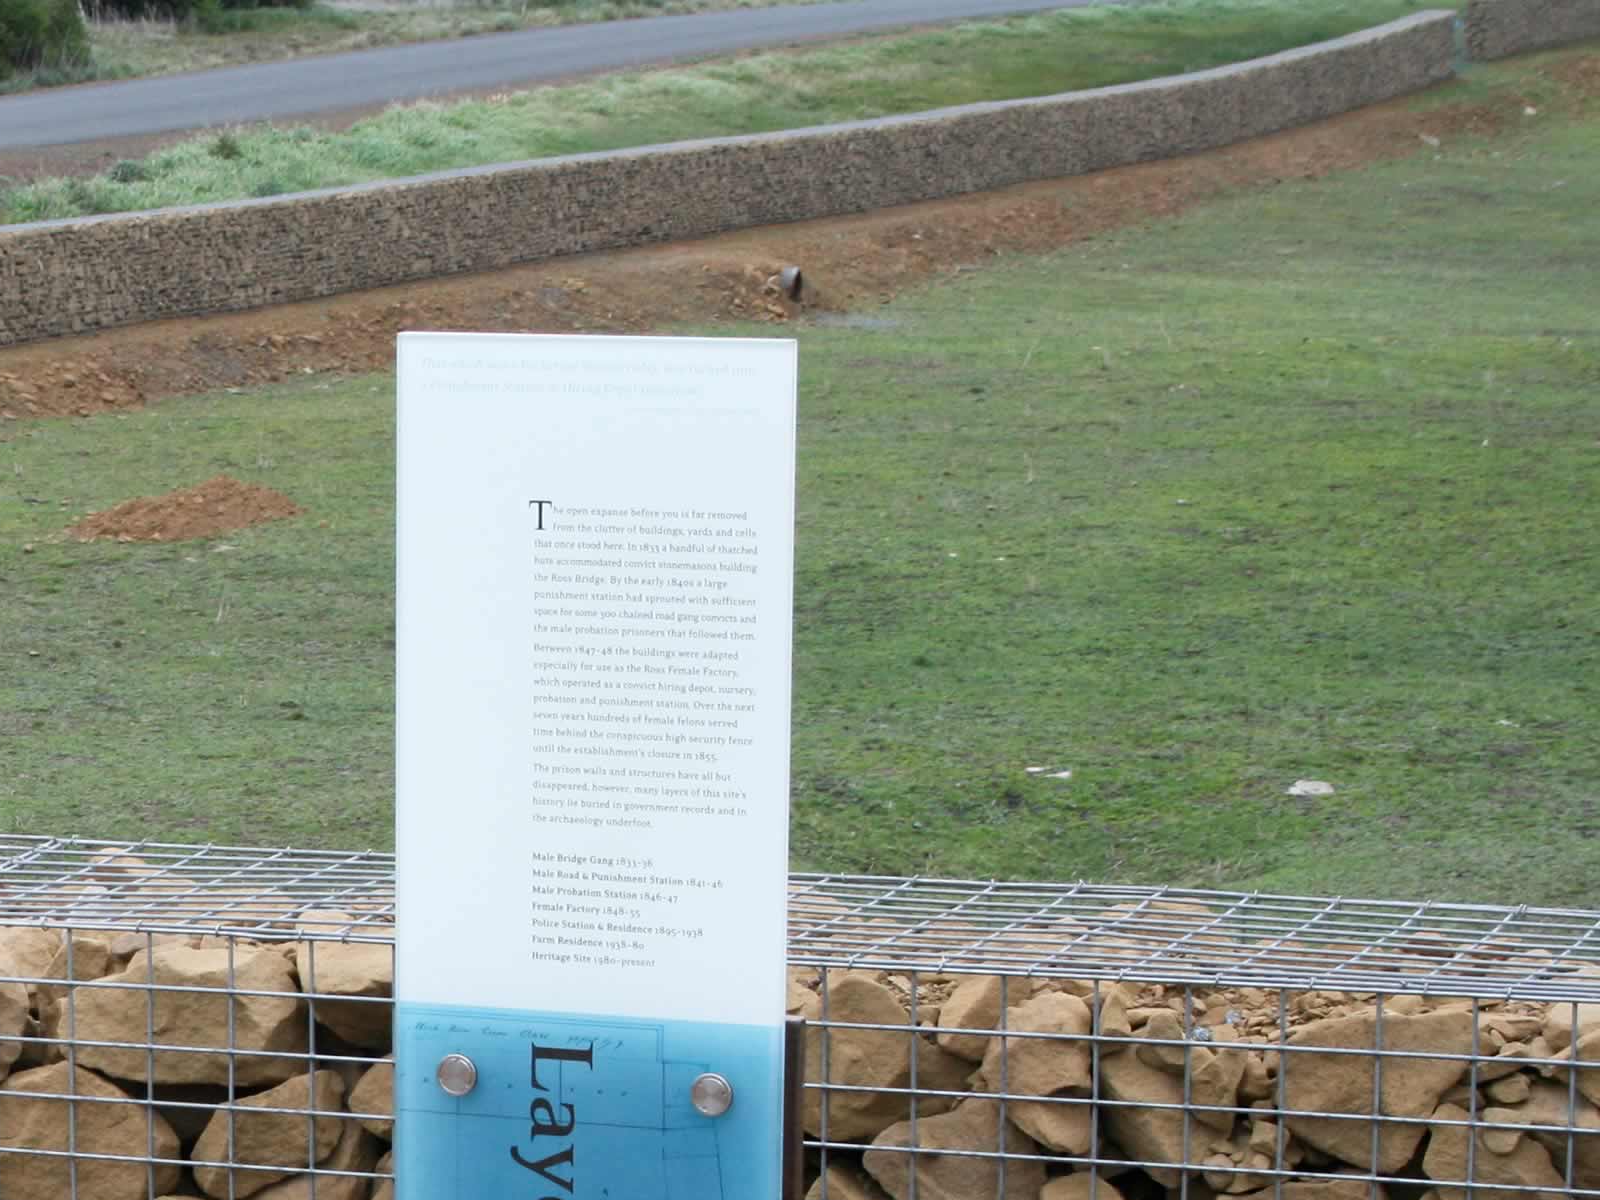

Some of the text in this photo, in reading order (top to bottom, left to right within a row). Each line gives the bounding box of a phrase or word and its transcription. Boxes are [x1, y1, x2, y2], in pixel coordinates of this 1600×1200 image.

[566, 508, 588, 518] open
[591, 508, 628, 519] expanse
[631, 507, 659, 518] before
[662, 511, 679, 521] you
[691, 509, 705, 519] far
[707, 510, 747, 520] removed
[553, 522, 575, 532] from
[578, 523, 592, 532] the
[594, 523, 624, 533] clutter
[627, 524, 636, 534] of
[687, 526, 713, 539] yards
[716, 527, 733, 537] and
[534, 538, 552, 548] that
[627, 541, 637, 551] In
[669, 543, 704, 553] handful
[706, 544, 716, 554] of
[718, 544, 758, 555] thatched
[624, 558, 656, 569] convict
[719, 562, 757, 575] building
[534, 572, 548, 582] the
[551, 573, 572, 583] Ross
[610, 575, 622, 587] By
[624, 575, 639, 585] the
[641, 576, 664, 589] early
[704, 578, 727, 591] large
[534, 589, 756, 607] punishment station had sprouted with sufficient
[560, 607, 572, 617] for
[701, 612, 737, 623] convicts
[740, 614, 756, 624] and
[534, 623, 548, 633] the
[550, 624, 572, 634] male
[575, 625, 619, 638] probation
[667, 628, 686, 638] that
[689, 629, 728, 640] followed
[534, 643, 572, 653] Between
[615, 646, 630, 656] the
[632, 647, 675, 660] buildings
[678, 650, 699, 658] were
[702, 649, 738, 662] adapted
[580, 662, 593, 671] for
[596, 664, 612, 672] use
[626, 663, 641, 673] the
[644, 664, 666, 674] Ross
[668, 665, 700, 675] Female
[534, 676, 560, 687] which
[562, 678, 601, 691] operated
[623, 680, 656, 691] convict
[658, 682, 686, 694] hiring
[533, 693, 755, 712] probation and punishment Over the next
[533, 712, 738, 728] seven years hundreds of female felons served
[533, 727, 553, 737] time
[556, 728, 587, 738] behind
[589, 729, 603, 739] the
[665, 732, 686, 745] high
[689, 734, 726, 747] security
[728, 735, 752, 745] fence
[533, 743, 555, 753] until
[557, 744, 571, 754] the
[647, 748, 680, 759] closure
[683, 750, 693, 760] in
[552, 764, 581, 777] prison
[583, 765, 606, 775] walls
[609, 766, 626, 776] and
[629, 767, 676, 779] structures
[678, 770, 699, 780] have
[702, 771, 713, 780] all
[715, 771, 731, 781] but
[634, 787, 658, 797] many
[661, 786, 688, 798] layers
[691, 787, 700, 797] of
[702, 788, 720, 798] this
[532, 796, 746, 816] history lie buried in government records and in
[532, 813, 604, 828] the archaeology
[532, 852, 614, 867] Male Bridge Gang
[532, 868, 555, 879] Male
[557, 870, 580, 880] Road
[591, 872, 647, 884] Punishment
[649, 875, 684, 886] Station
[532, 885, 555, 895] Male
[557, 886, 602, 898] Probation
[604, 889, 637, 900] Station
[532, 901, 601, 917] Female Factory
[532, 918, 559, 928] Police
[561, 920, 595, 930] Station
[606, 922, 652, 934] Residence
[531, 934, 556, 945] Farm
[557, 936, 603, 947] Residence
[532, 951, 592, 964] Heritage Site
